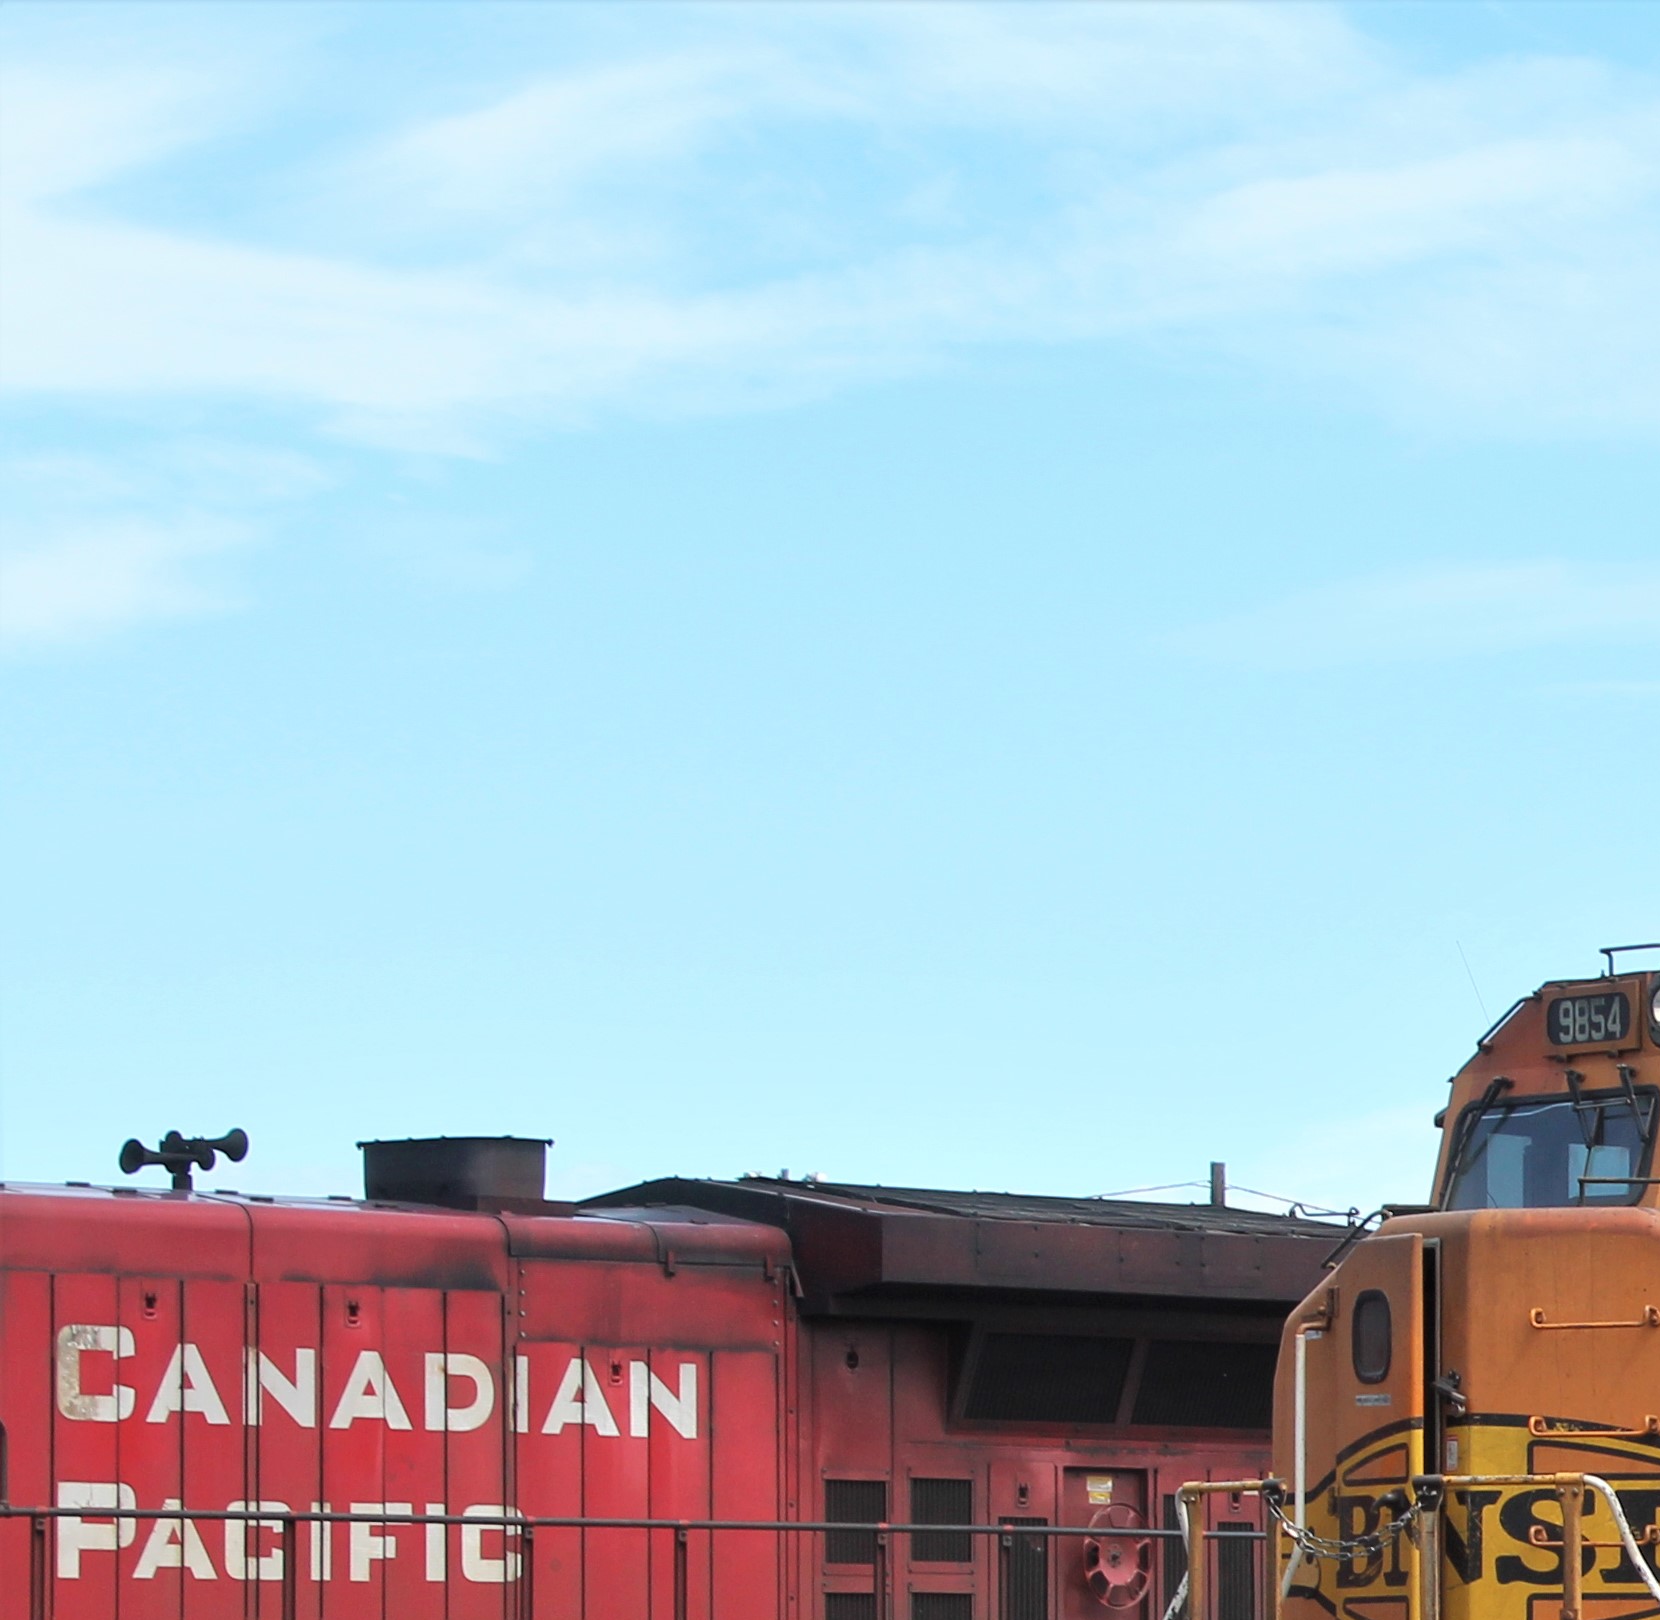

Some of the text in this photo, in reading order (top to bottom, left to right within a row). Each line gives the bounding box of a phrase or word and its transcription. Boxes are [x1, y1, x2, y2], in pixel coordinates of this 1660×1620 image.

[1558, 997, 1622, 1044] 9854
[56, 1324, 699, 1440] CANADIAN
[56, 1481, 526, 1584] PACIFIC
